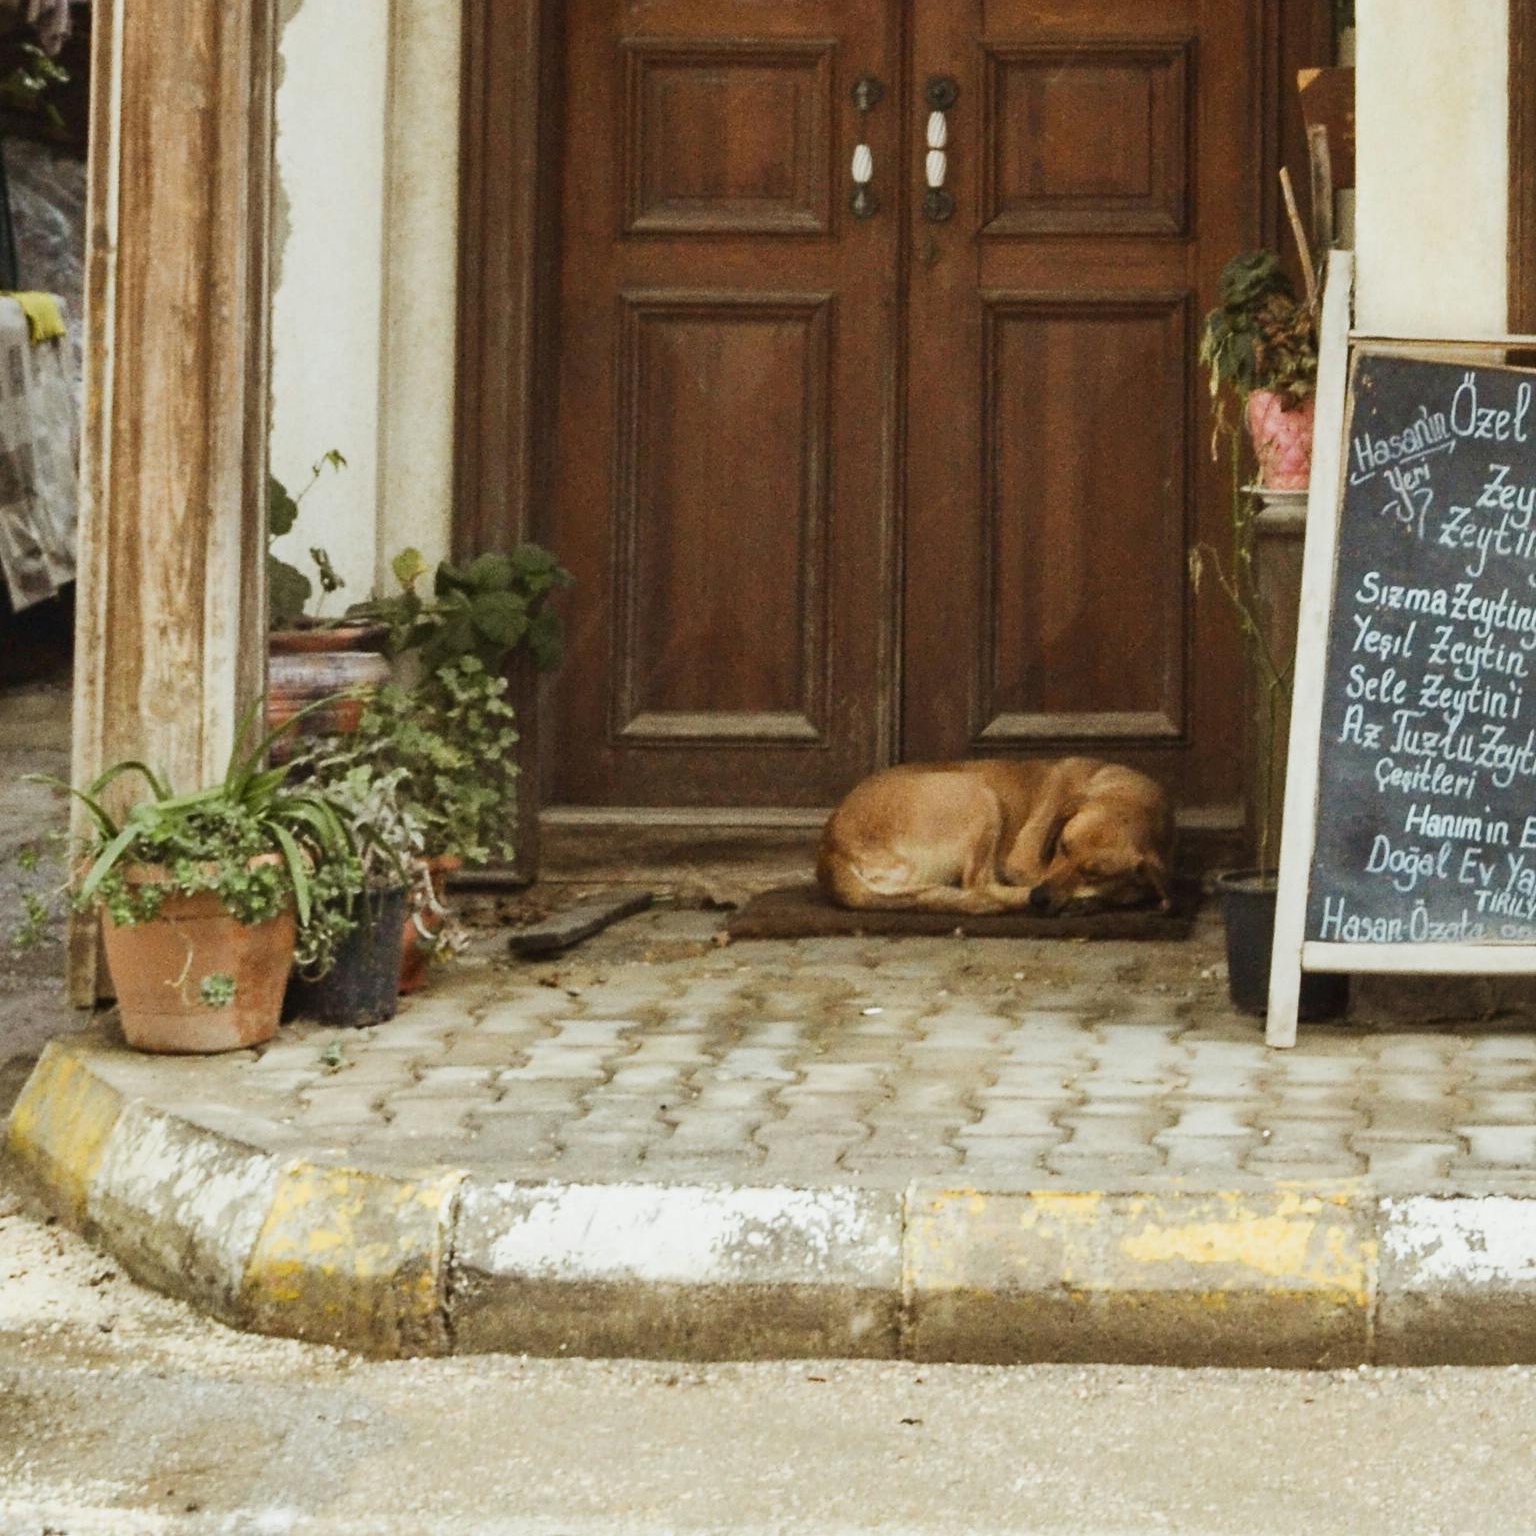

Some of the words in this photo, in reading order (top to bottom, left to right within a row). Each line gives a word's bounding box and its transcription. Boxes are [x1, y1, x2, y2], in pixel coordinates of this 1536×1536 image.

[1451, 372, 1532, 442] Özel
[1383, 457, 1431, 522] Yeri
[1355, 571, 1448, 616] Sızma
[1428, 625, 1529, 681] Zeytin
[1346, 664, 1408, 704] Sele
[1418, 674, 1523, 724] Zeytin'i
[1337, 703, 1385, 749] Az
[1390, 709, 1475, 763] Tuzlu
[1375, 756, 1478, 800] Çeşitleri
[1365, 834, 1452, 893] Doğal
[1458, 847, 1496, 887] Ev
